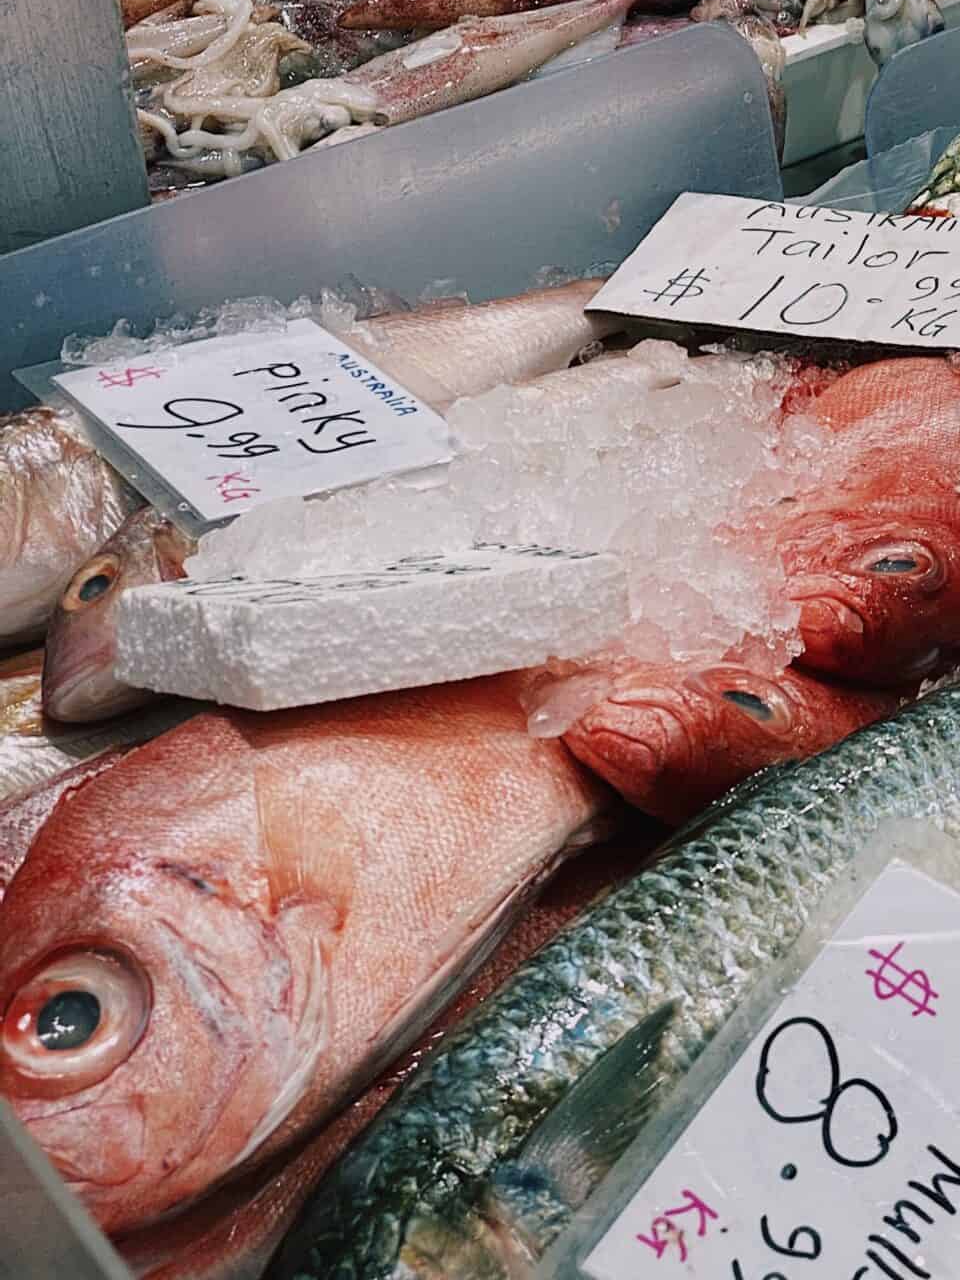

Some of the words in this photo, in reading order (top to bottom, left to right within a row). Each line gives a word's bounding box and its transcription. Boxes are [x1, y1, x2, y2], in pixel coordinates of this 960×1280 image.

[740, 227, 951, 270] Tailor
[890, 306, 959, 340] KG
[865, 940, 940, 1018] $
